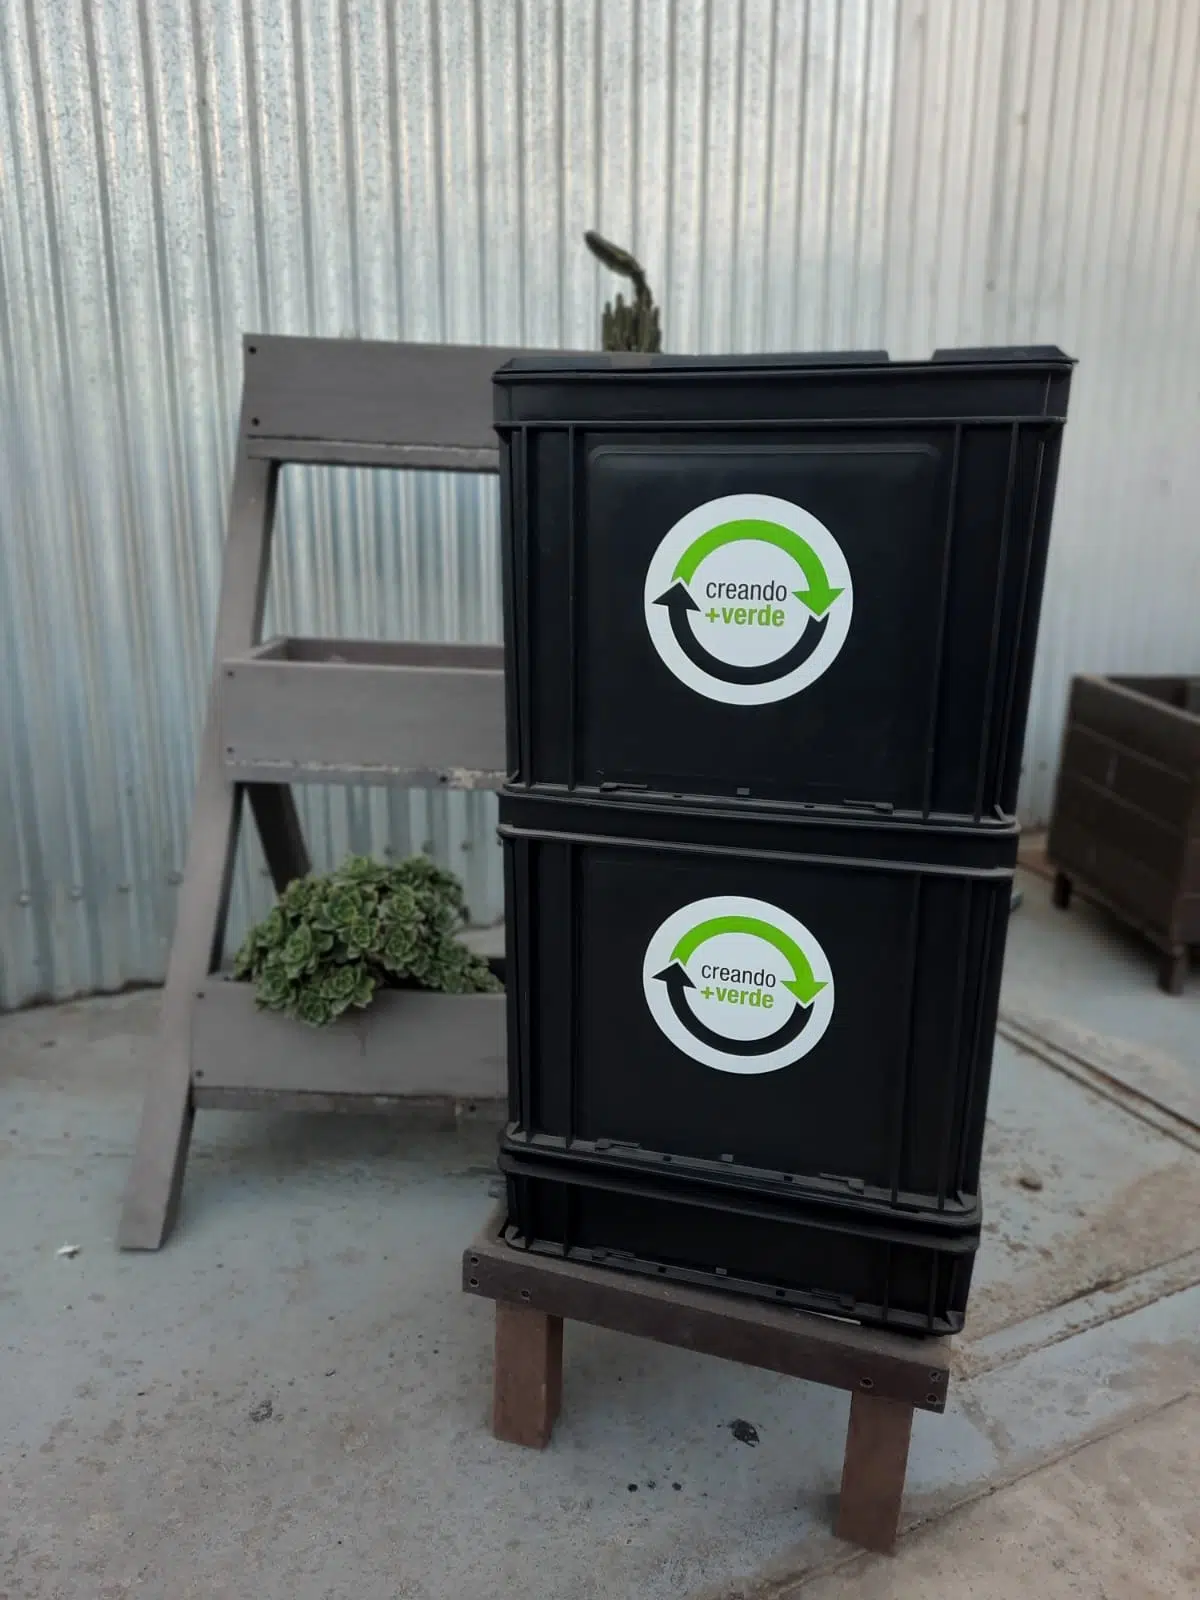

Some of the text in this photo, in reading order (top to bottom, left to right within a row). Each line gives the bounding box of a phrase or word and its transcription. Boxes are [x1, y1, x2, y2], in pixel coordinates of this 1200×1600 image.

[706, 580, 788, 601] creando
[705, 604, 785, 627] +verde
[701, 965, 776, 988] creando
[700, 986, 774, 1009] +verde
